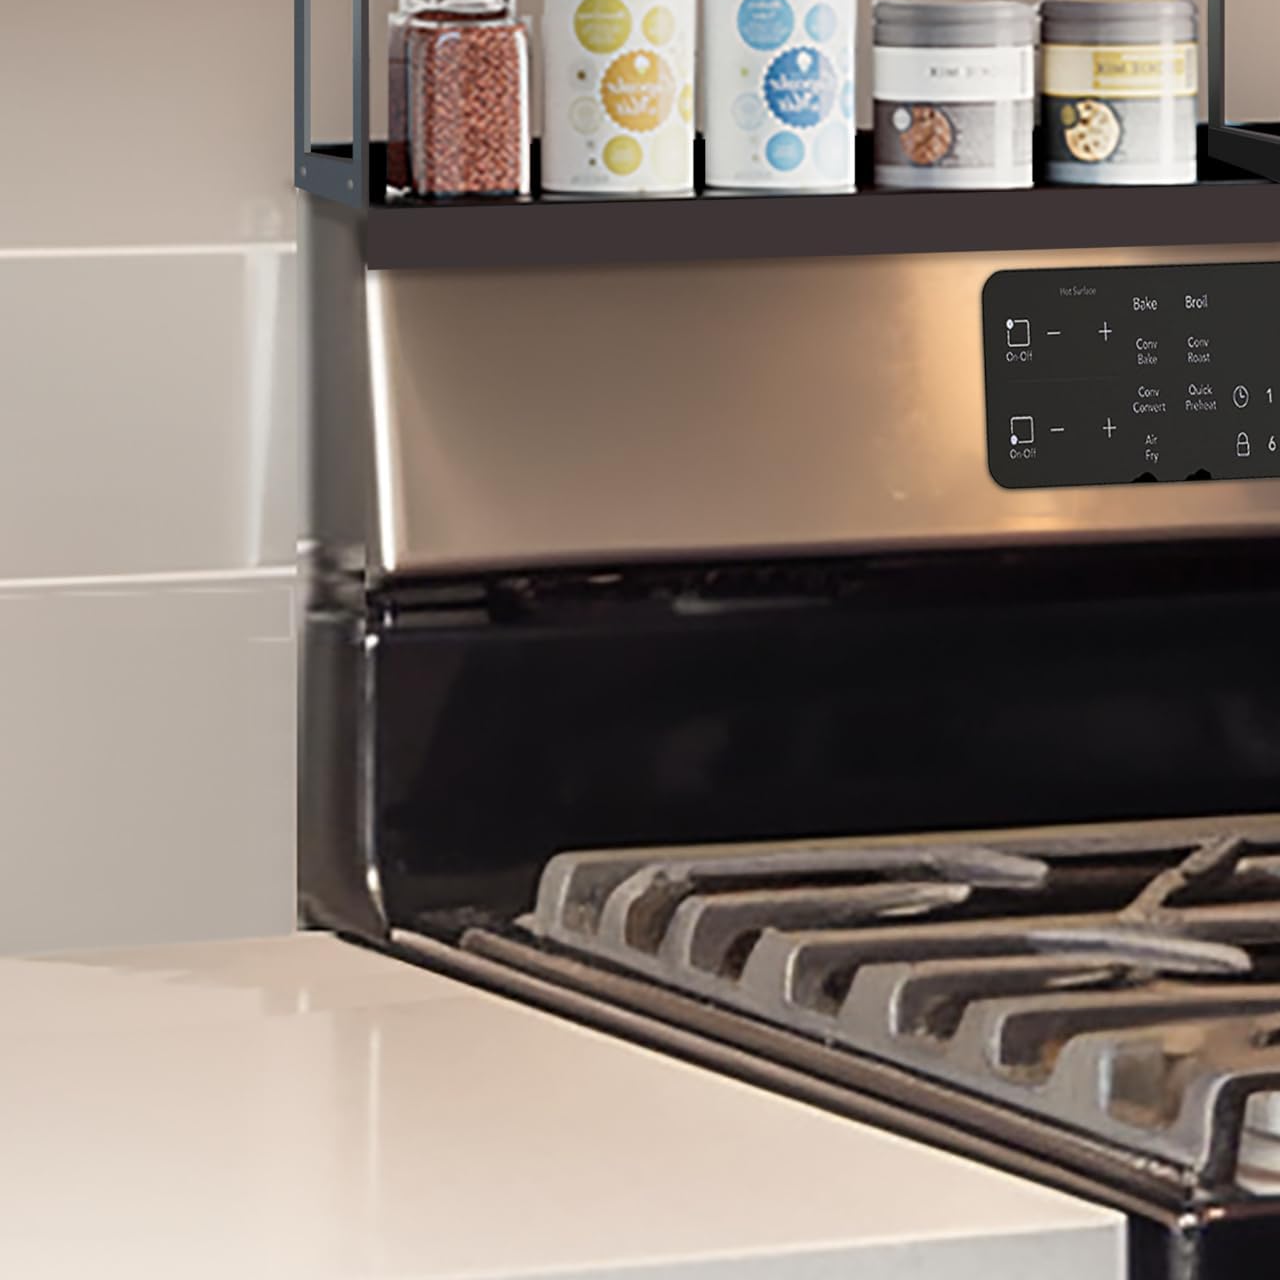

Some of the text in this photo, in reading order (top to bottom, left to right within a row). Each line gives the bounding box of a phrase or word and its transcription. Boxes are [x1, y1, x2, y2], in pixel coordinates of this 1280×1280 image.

[1133, 296, 1158, 311] Bake
[1266, 388, 1273, 403] 1
[1268, 435, 1276, 451] 6
[1145, 449, 1160, 463] Fry
